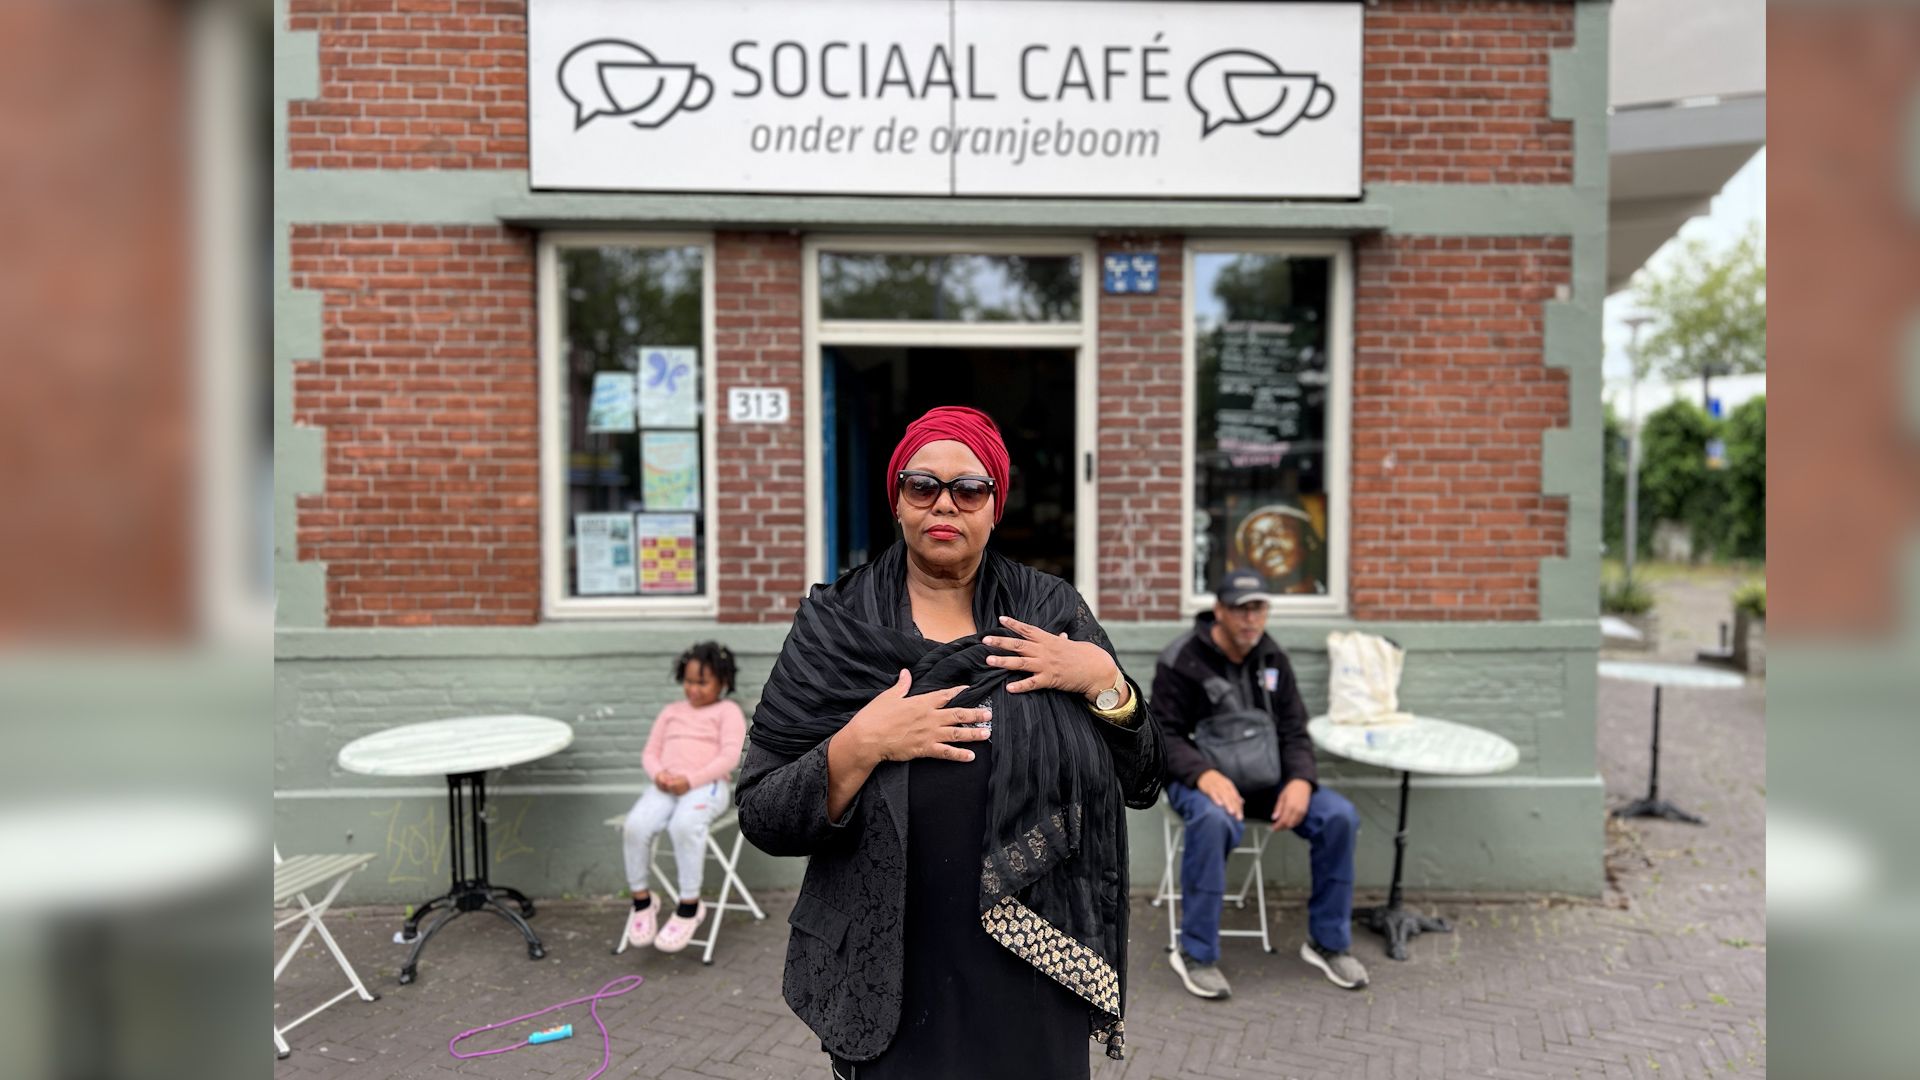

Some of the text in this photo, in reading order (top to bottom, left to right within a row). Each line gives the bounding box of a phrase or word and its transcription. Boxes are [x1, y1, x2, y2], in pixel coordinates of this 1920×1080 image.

[731, 32, 1170, 101] SOCIAAL CAFÉ
[751, 116, 1160, 166] onder de oranjeboom
[735, 392, 783, 419] 313
